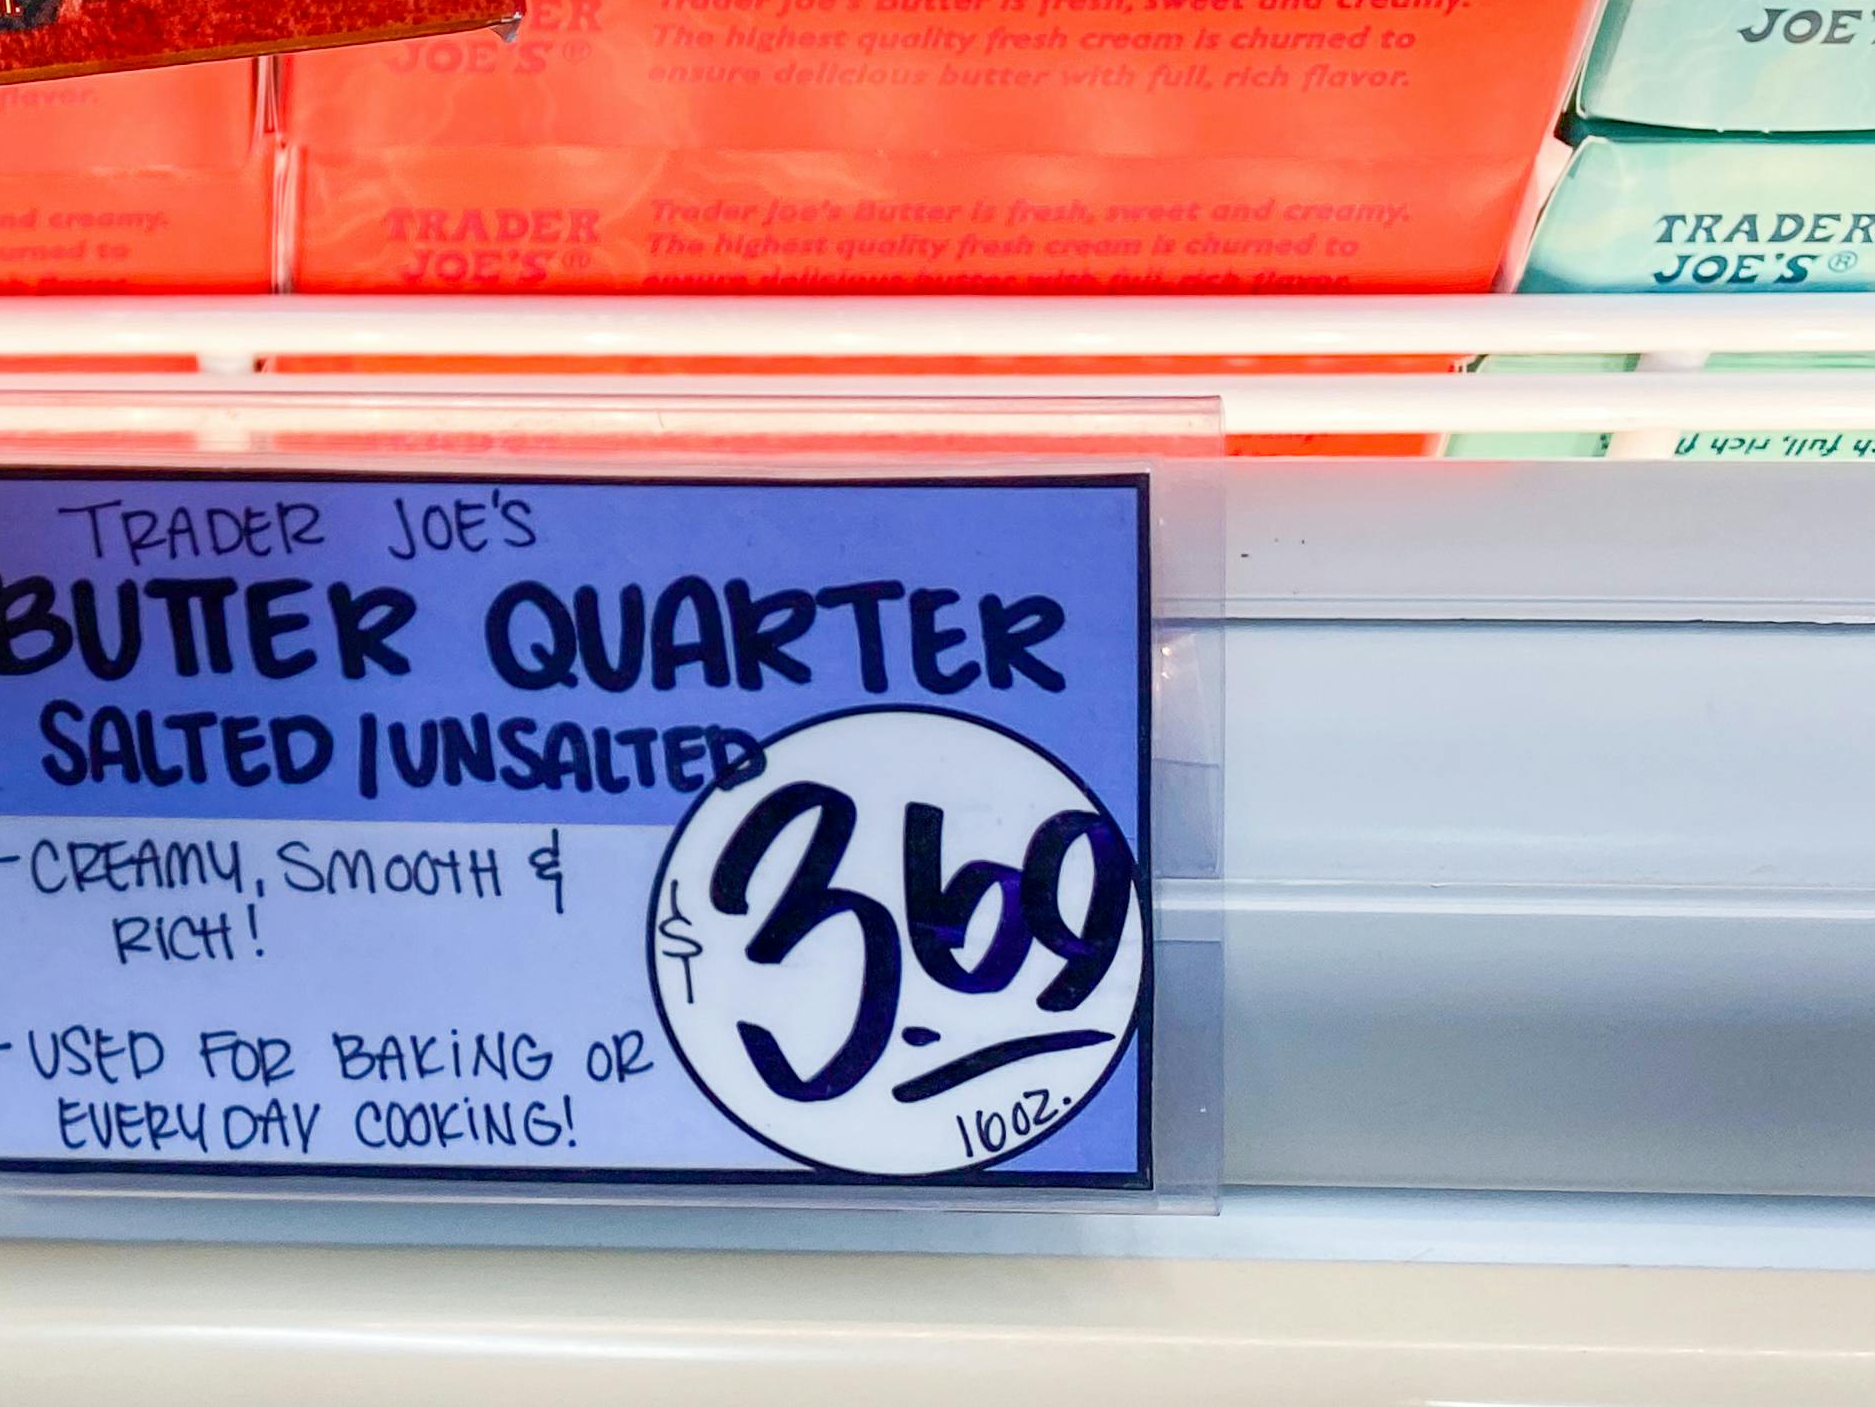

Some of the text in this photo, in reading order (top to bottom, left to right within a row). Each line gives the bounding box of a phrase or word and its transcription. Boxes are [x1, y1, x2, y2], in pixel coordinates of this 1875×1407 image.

[1736, 8, 1875, 45] JOE
[1653, 214, 1875, 243] TRADER
[1710, 437, 1771, 455] rich
[58, 489, 537, 567] TRADER JOE'S
[485, 574, 1067, 695] QUARTER
[277, 837, 503, 899] SMOOTH
[529, 828, 565, 914] &
[112, 903, 265, 964] RICH!
[29, 1026, 655, 1084] USED FOR BAKING OR
[354, 1093, 579, 1150] COOKING!
